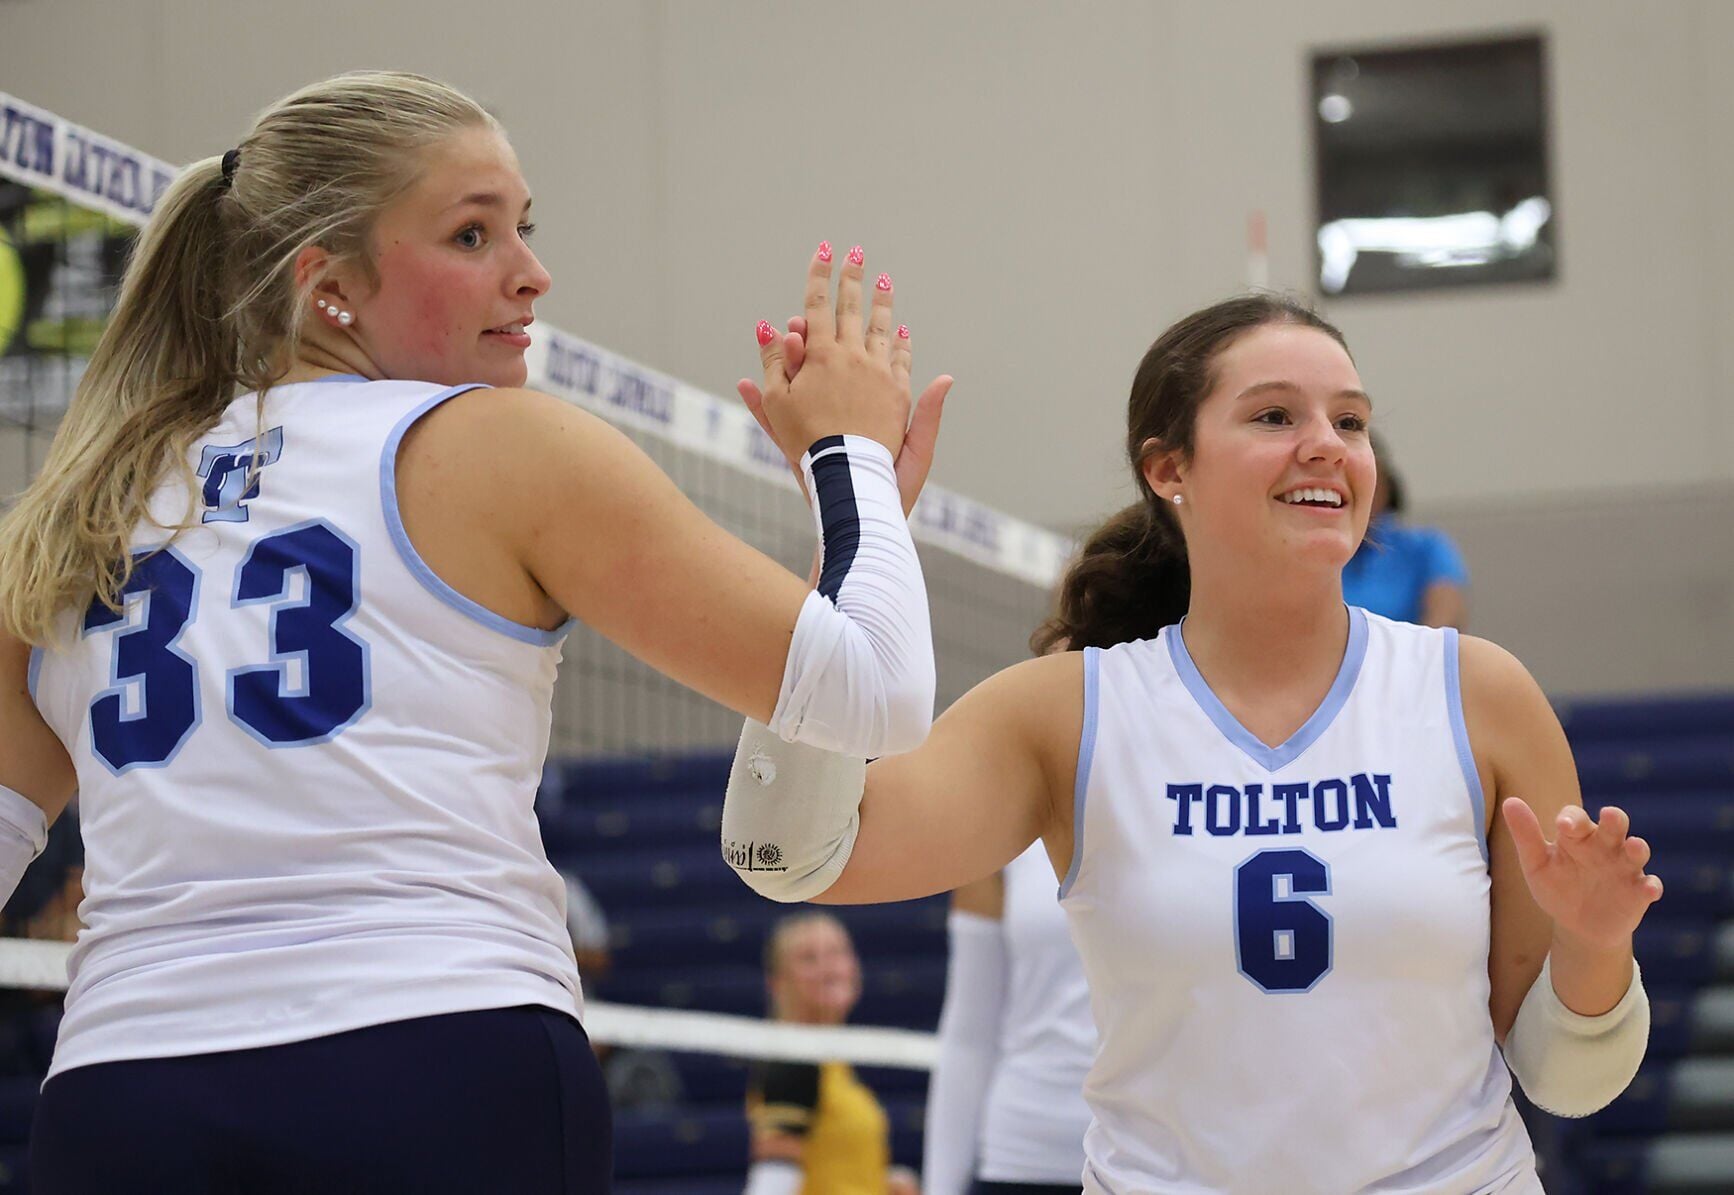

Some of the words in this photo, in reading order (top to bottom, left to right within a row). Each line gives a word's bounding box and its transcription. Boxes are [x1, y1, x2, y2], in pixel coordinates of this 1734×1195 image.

[77, 517, 372, 777] 33
[1166, 773, 1398, 837] TOLTON
[1233, 846, 1334, 995] 6
